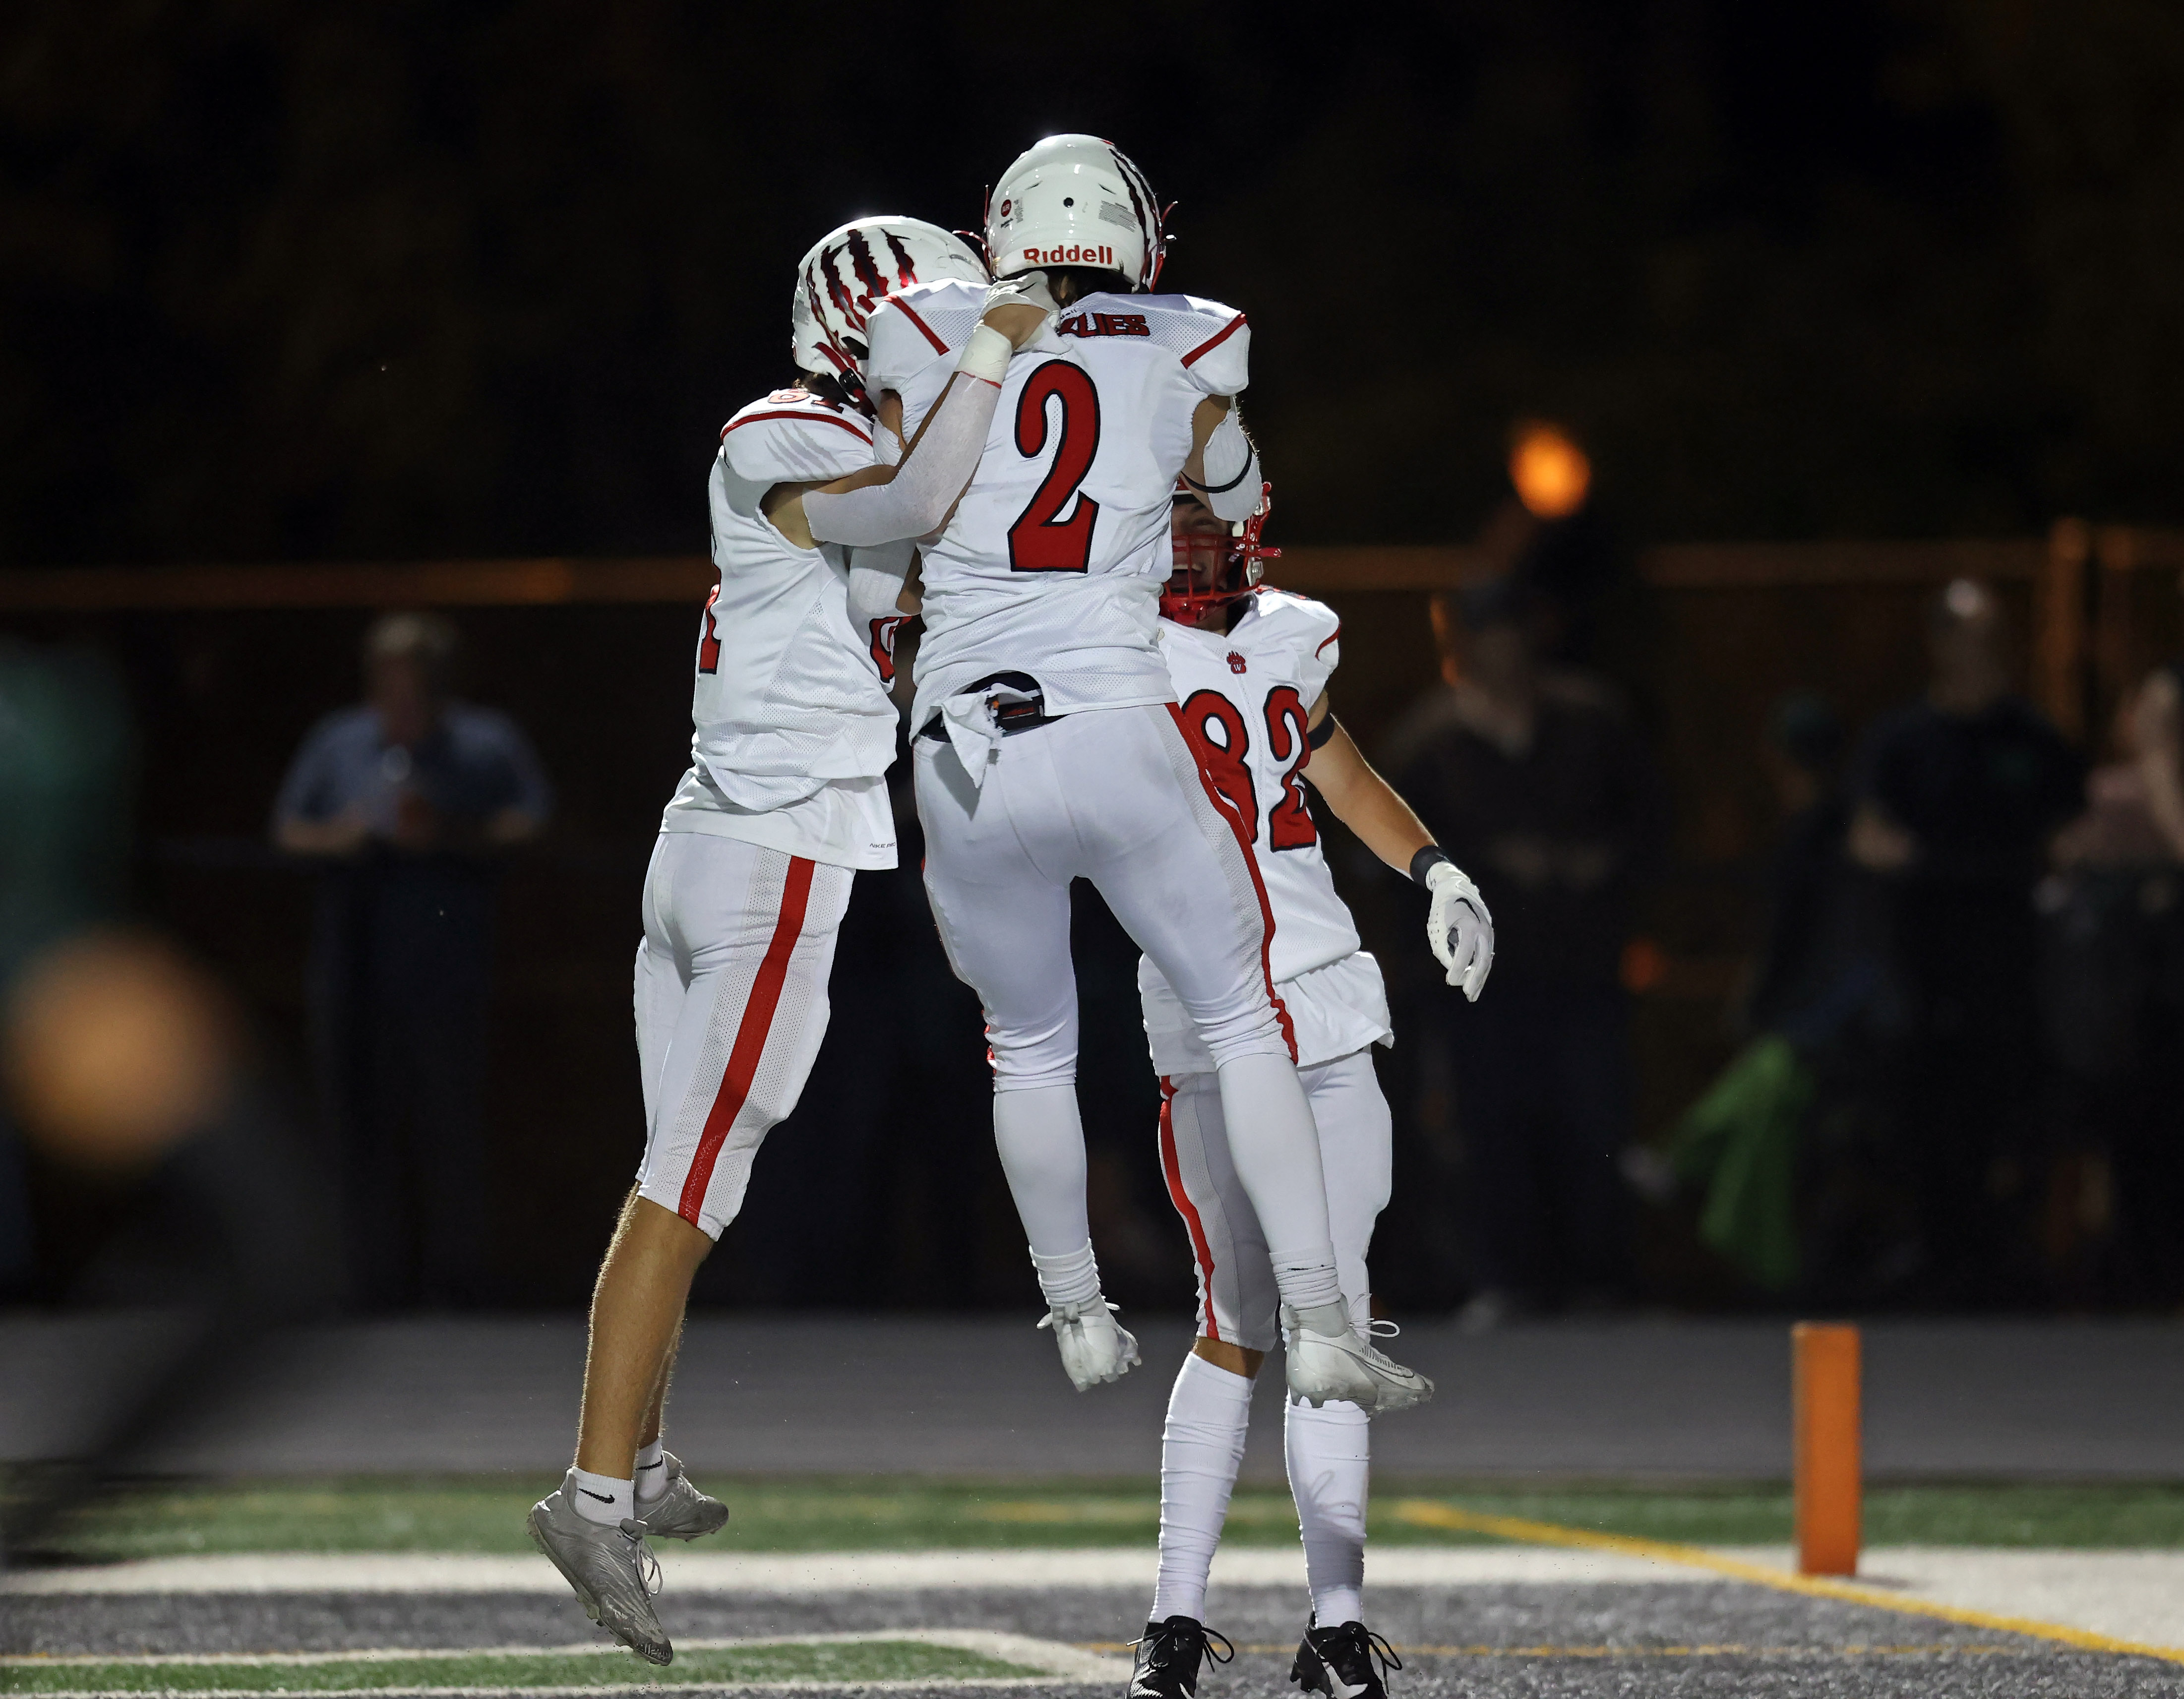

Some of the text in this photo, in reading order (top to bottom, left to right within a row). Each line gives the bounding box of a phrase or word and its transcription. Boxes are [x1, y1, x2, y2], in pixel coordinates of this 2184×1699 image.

[1023, 244, 1112, 265] Riddell
[1007, 359, 1100, 573] 2
[1181, 685, 1317, 853] 82
